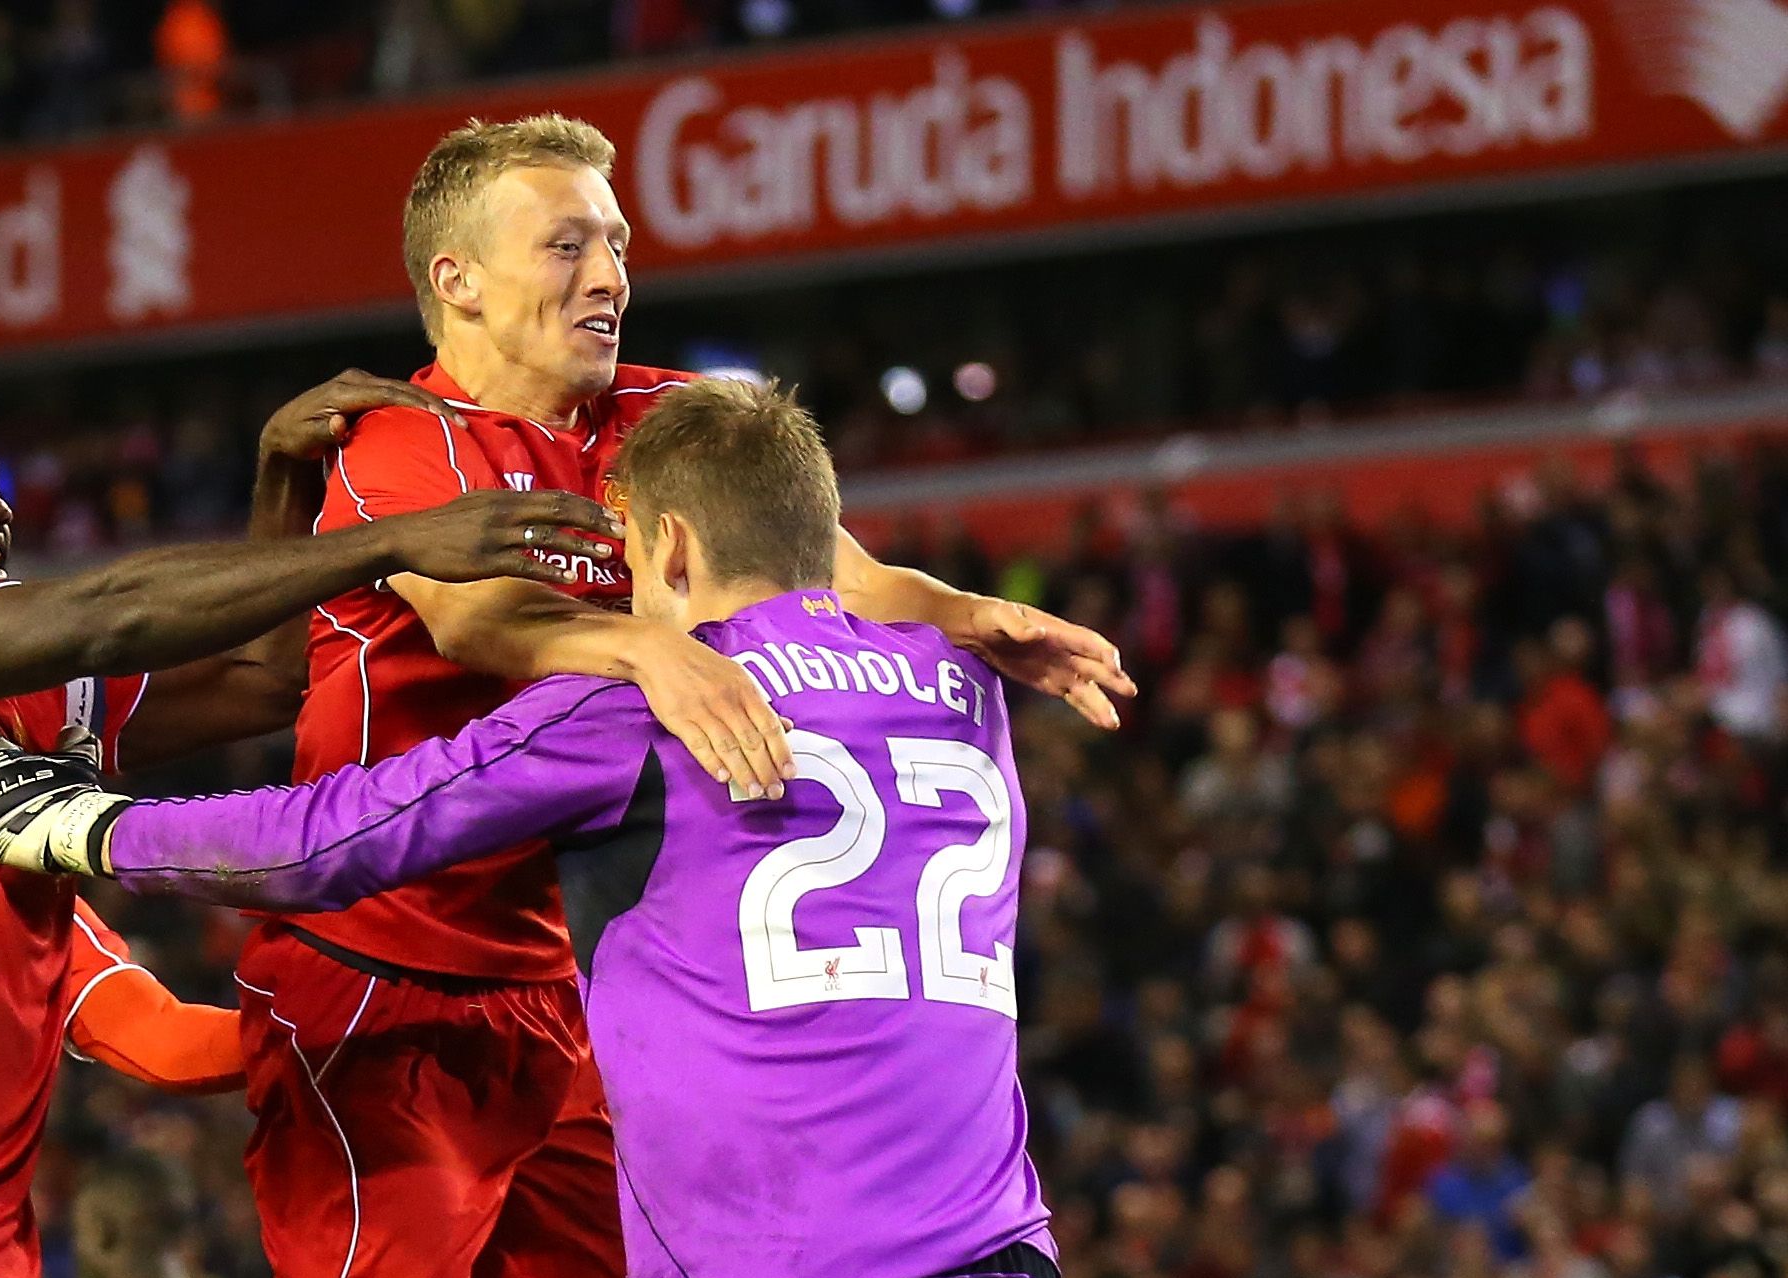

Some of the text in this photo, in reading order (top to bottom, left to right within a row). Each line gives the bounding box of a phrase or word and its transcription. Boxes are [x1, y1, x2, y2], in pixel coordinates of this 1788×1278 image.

[635, 8, 1594, 246] Garuda Indonesia
[727, 728, 1018, 1020] 22
